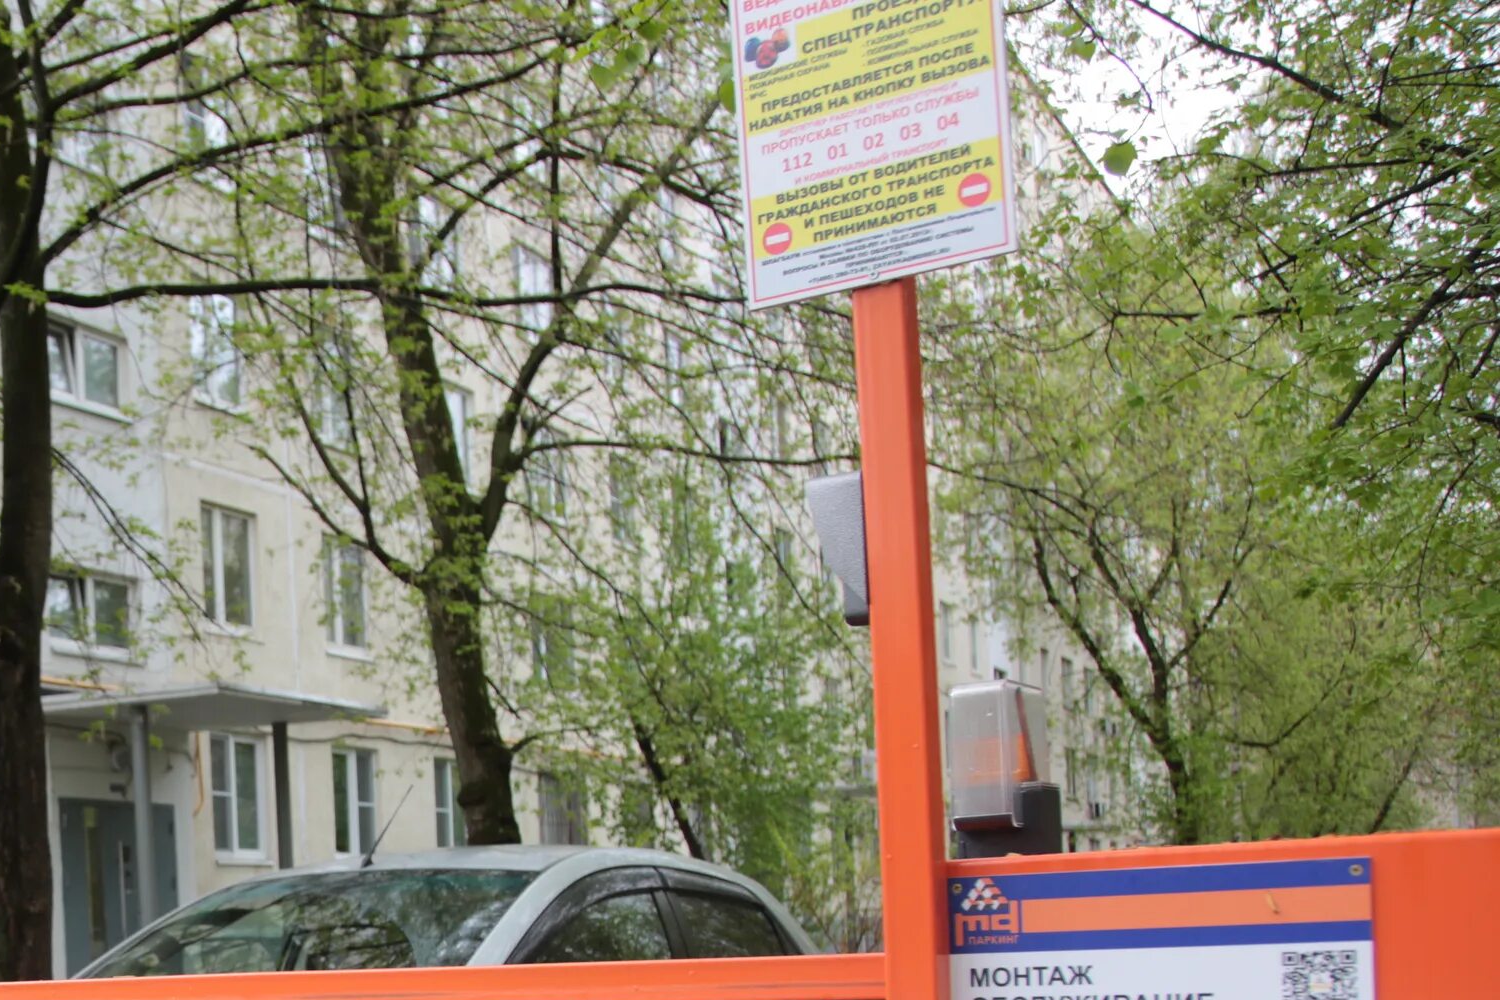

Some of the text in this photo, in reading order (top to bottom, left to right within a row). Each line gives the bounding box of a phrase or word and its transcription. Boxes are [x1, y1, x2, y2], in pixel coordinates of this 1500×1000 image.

[749, 55, 990, 131] НАЖАТИЯ НА КНОПКУ ВЫЗОВА
[761, 43, 974, 112] ПРЕДОСТАВЛЯЕТСЯ ПОСЛЕ
[762, 86, 979, 155] ПРОПУСКАЕТ ТОЛЬКО СЛУЖБЫ
[782, 111, 959, 173] 112 01 02 03 04
[757, 156, 995, 225] ГРАЖДАНСКОГО ТРАНСПОРТА
[776, 143, 971, 205] ВЫЗОВЫ ОТ ВОДИТЕЛЕЙ
[804, 184, 946, 229] И ПЕШЕХОДОВ НЕ
[813, 203, 937, 243] ПРИНИМАЮТСЯ
[968, 934, 1020, 945] ПАРКИНГ
[969, 965, 1093, 988] МОНТАЖ
